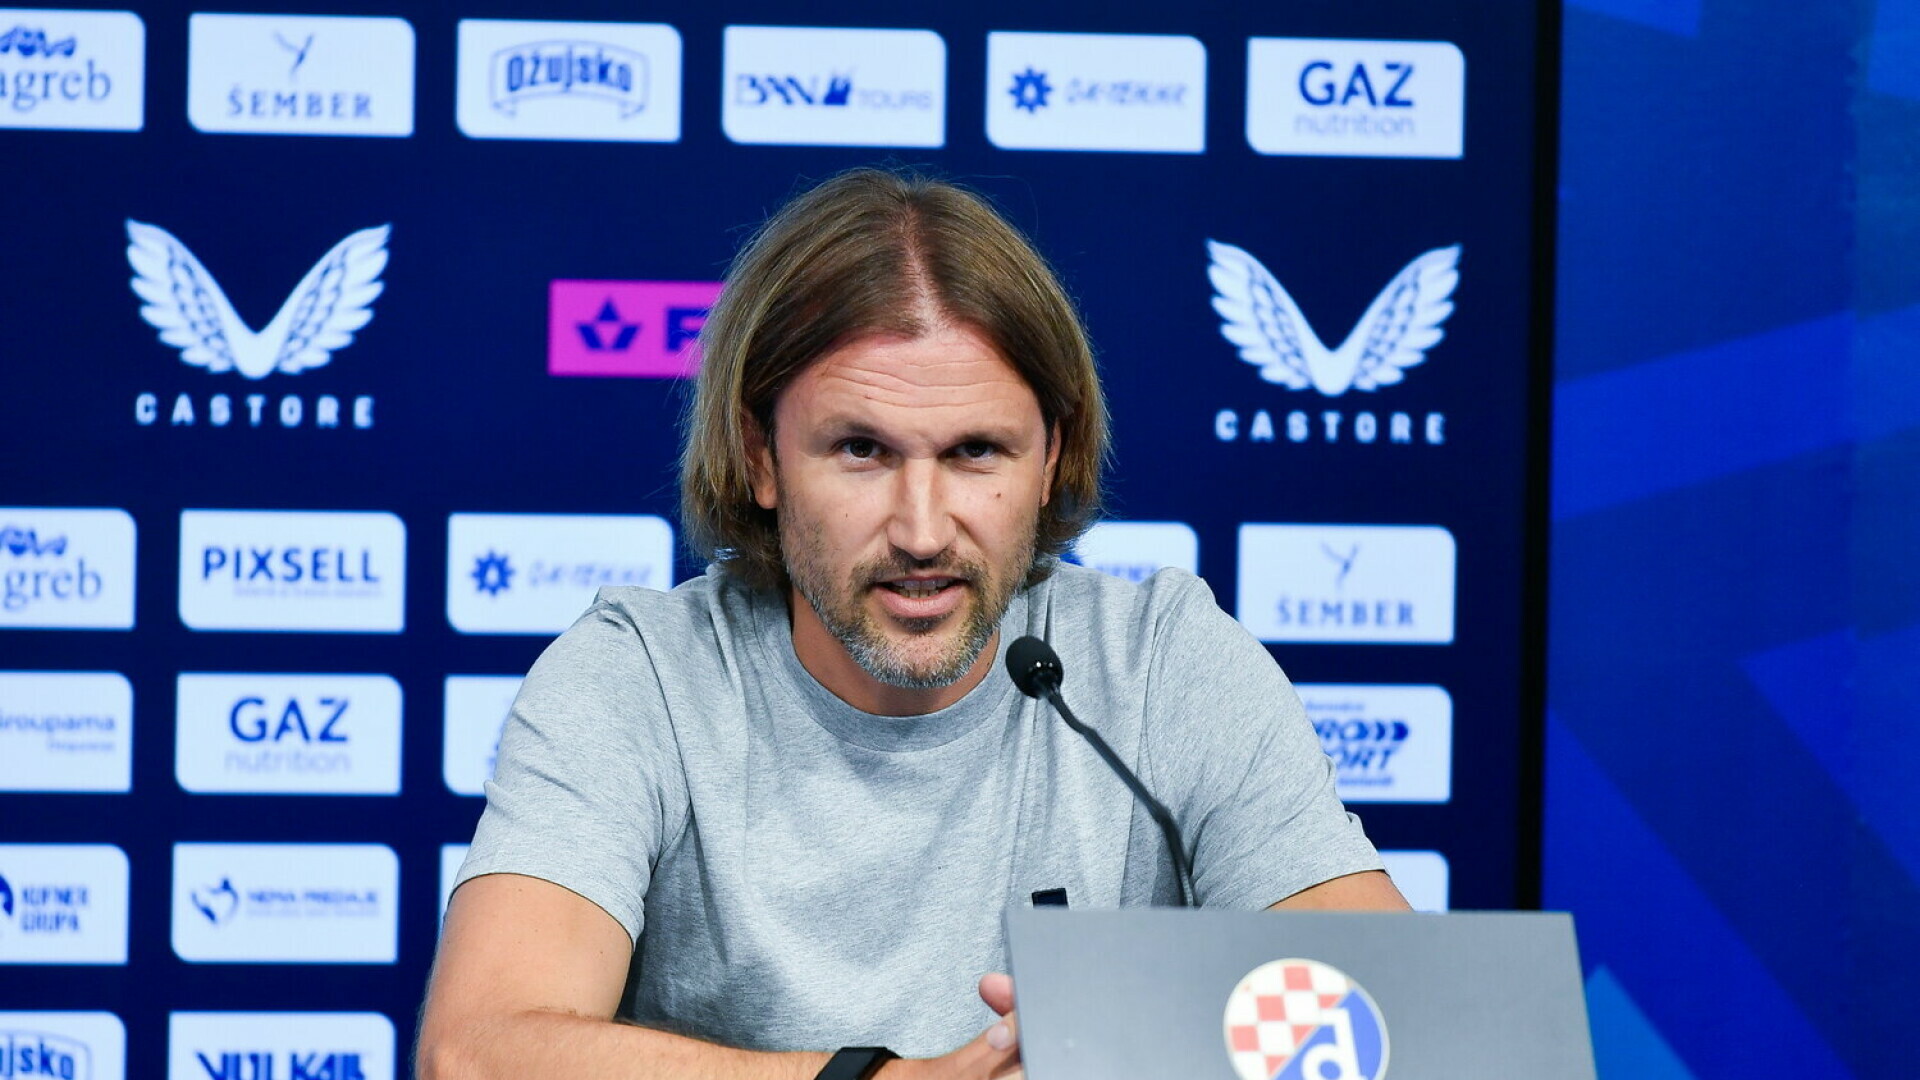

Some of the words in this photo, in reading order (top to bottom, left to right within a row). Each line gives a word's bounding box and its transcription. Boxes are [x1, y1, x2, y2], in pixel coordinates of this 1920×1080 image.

[1297, 59, 1415, 108] GAZ
[1295, 110, 1416, 138] nutrition
[663, 306, 712, 353] F
[135, 393, 374, 428] CASTORE
[1214, 409, 1444, 444] CASTORE
[202, 546, 380, 583] PIXSELL
[1276, 597, 1415, 627] ŠEMBER
[228, 695, 350, 742] GAZ
[224, 748, 351, 774] nutrition
